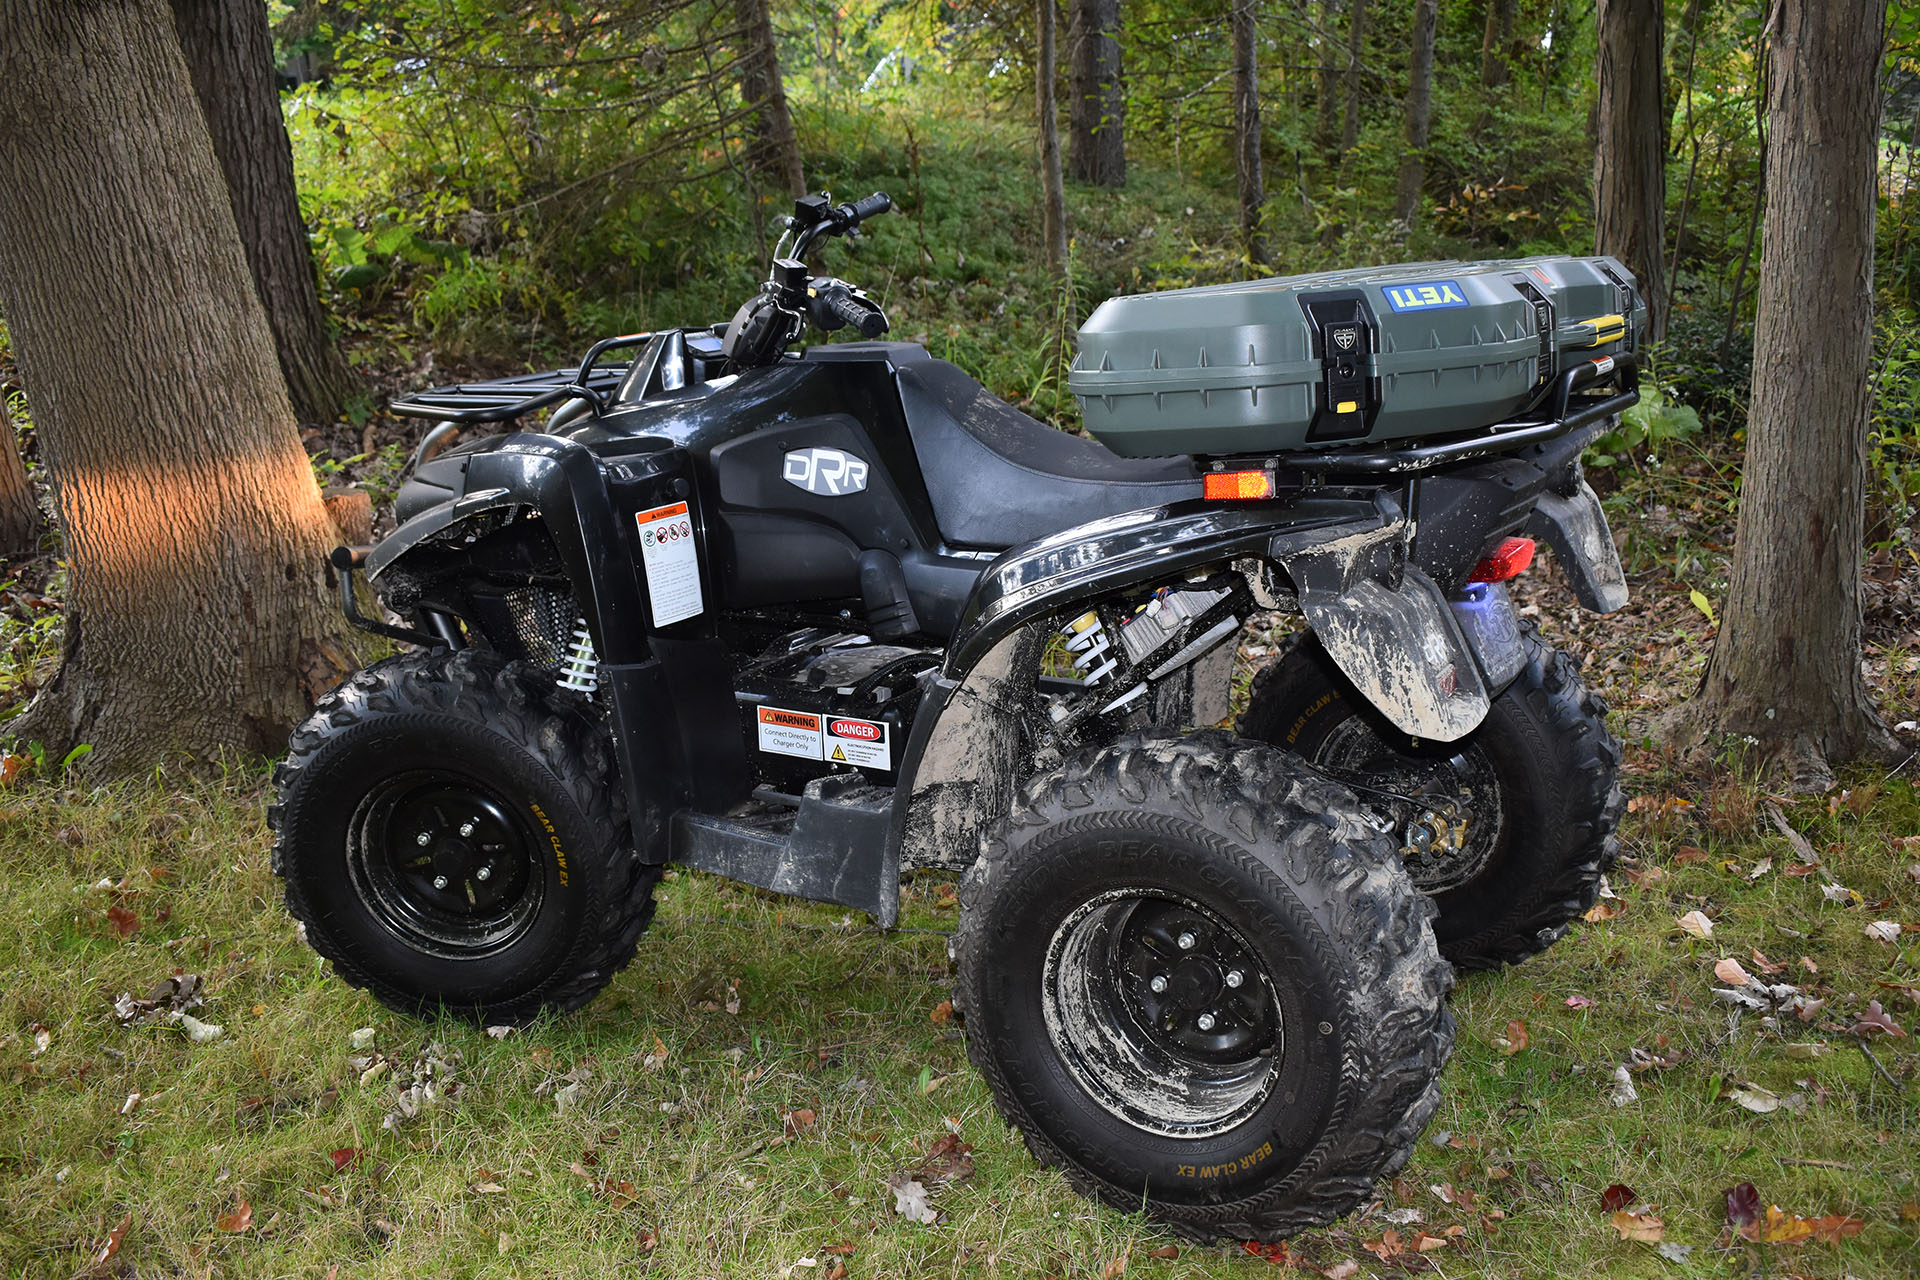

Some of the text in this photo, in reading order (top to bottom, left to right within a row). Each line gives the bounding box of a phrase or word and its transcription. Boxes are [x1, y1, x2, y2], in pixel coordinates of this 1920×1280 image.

[1390, 285, 1463, 308] YETI
[785, 448, 867, 494] DRR
[656, 507, 677, 518] WARNING
[774, 712, 816, 729] WARNING
[836, 722, 875, 738] DANGER
[1286, 715, 1307, 744] BEAR
[1304, 693, 1331, 718] CLAW
[764, 727, 817, 743] Connect Directly to
[773, 738, 809, 751] Charger Only
[529, 803, 569, 887] BEAR CLAW EX
[1092, 839, 1192, 872] BEAR
[1177, 1141, 1273, 1178] BEAR CLAW EX
